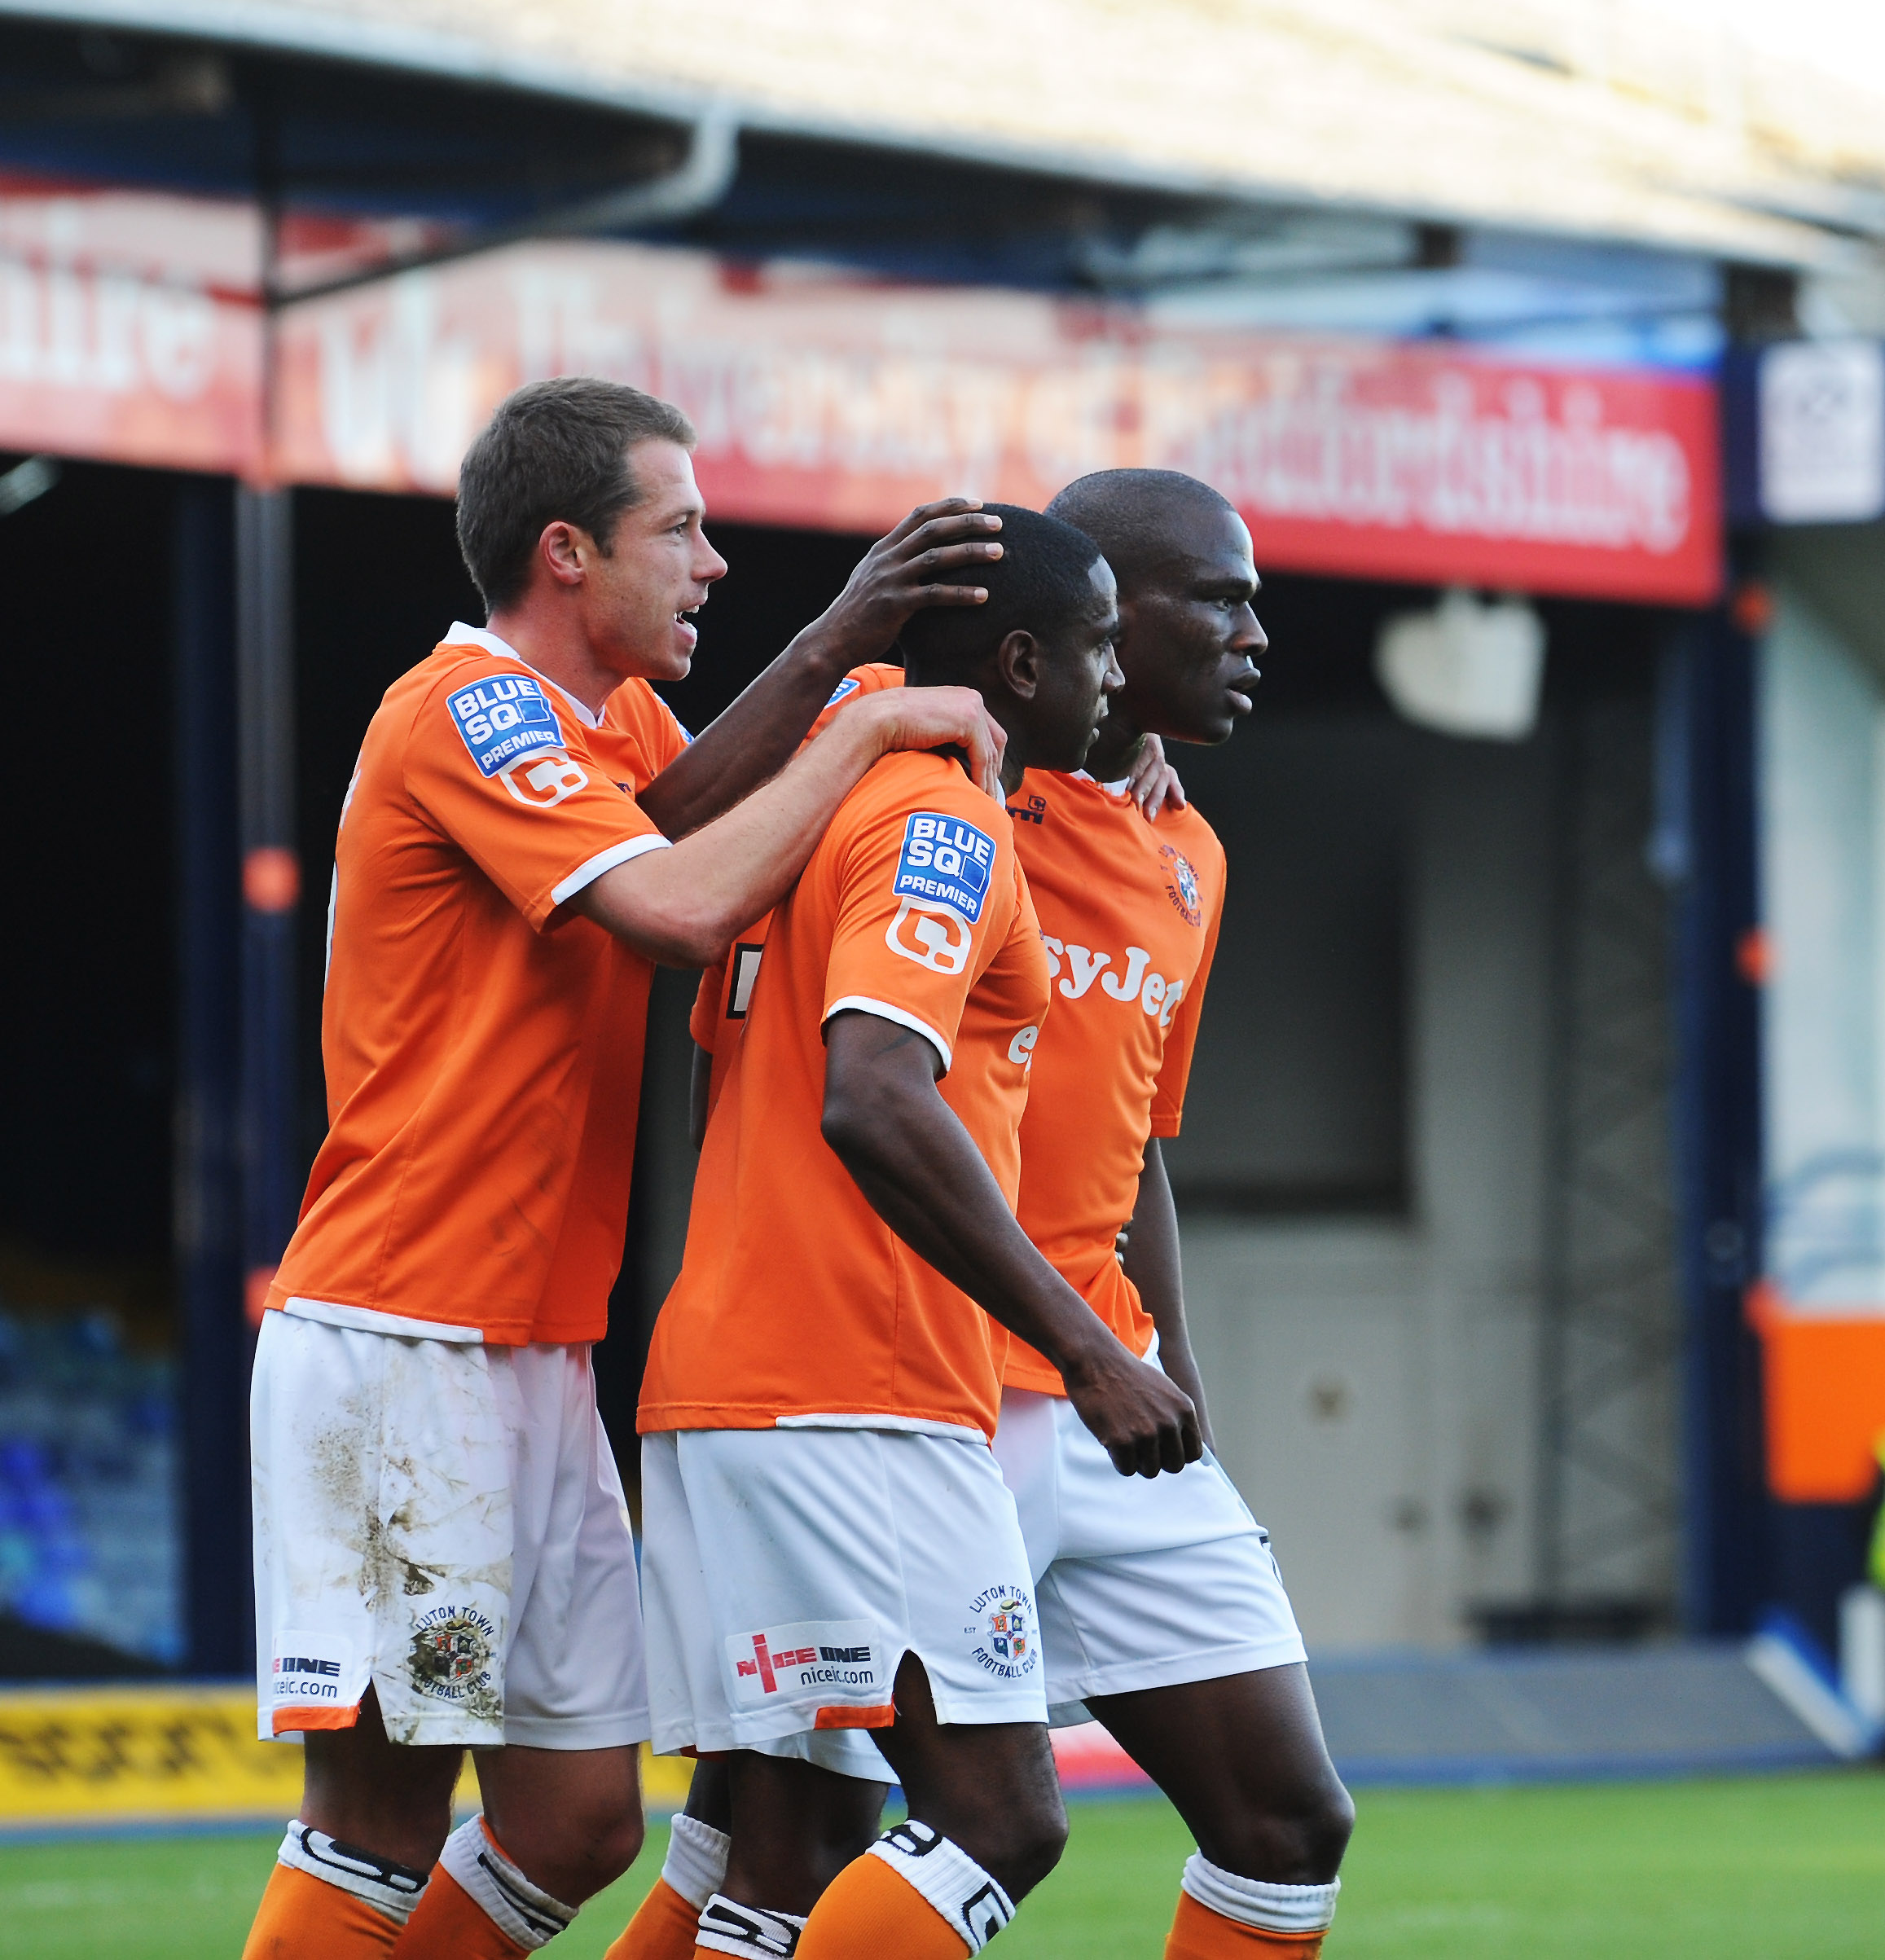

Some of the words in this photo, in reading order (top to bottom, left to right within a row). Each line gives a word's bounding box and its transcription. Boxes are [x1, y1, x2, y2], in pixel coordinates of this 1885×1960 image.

[454, 679, 539, 721] BLUE
[480, 730, 557, 769] PREMIER
[912, 818, 991, 865] BLUE
[899, 875, 978, 915] PREMIER
[969, 1584, 1007, 1613] LUTON
[415, 1606, 456, 1632] LUTON
[461, 1606, 494, 1637] TOWN
[801, 1666, 874, 1685] niceic.com
[971, 1646, 1022, 1679] FOOTBALL
